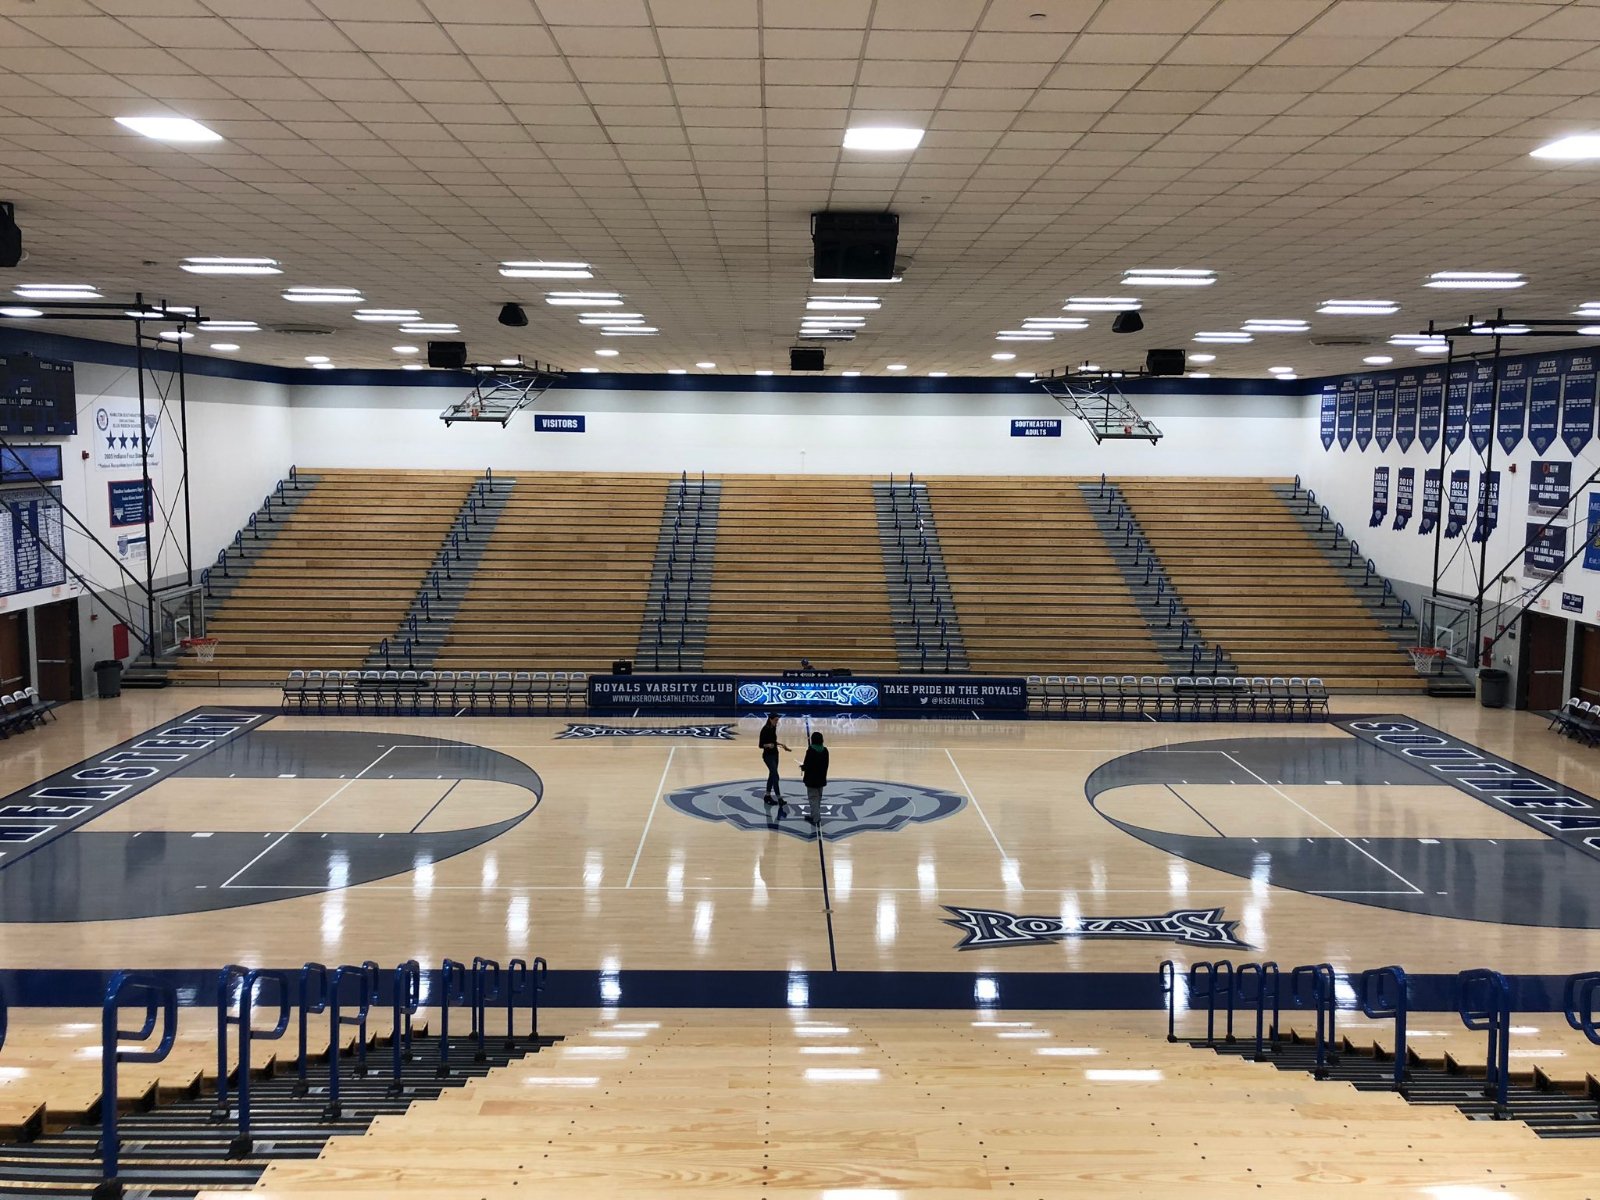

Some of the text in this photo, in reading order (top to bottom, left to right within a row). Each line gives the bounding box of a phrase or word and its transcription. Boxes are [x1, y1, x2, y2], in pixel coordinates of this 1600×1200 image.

[542, 419, 578, 428] VISITORS
[1399, 478, 1413, 486] 2019
[1425, 480, 1440, 488] 2018
[1480, 483, 1498, 491] 213
[1534, 555, 1554, 563] CHAMPIONS
[594, 683, 733, 692] ROYALS VARSITY CLUB
[884, 685, 1022, 695] TAKE PRIDE IN THE ROYALS!
[764, 684, 854, 705] ROYALS
[932, 697, 984, 705] @HSEATHLETICS
[561, 724, 736, 740] ROYALS
[1349, 722, 1600, 850] SOUTHEA
[948, 906, 1246, 948] ROYALS
